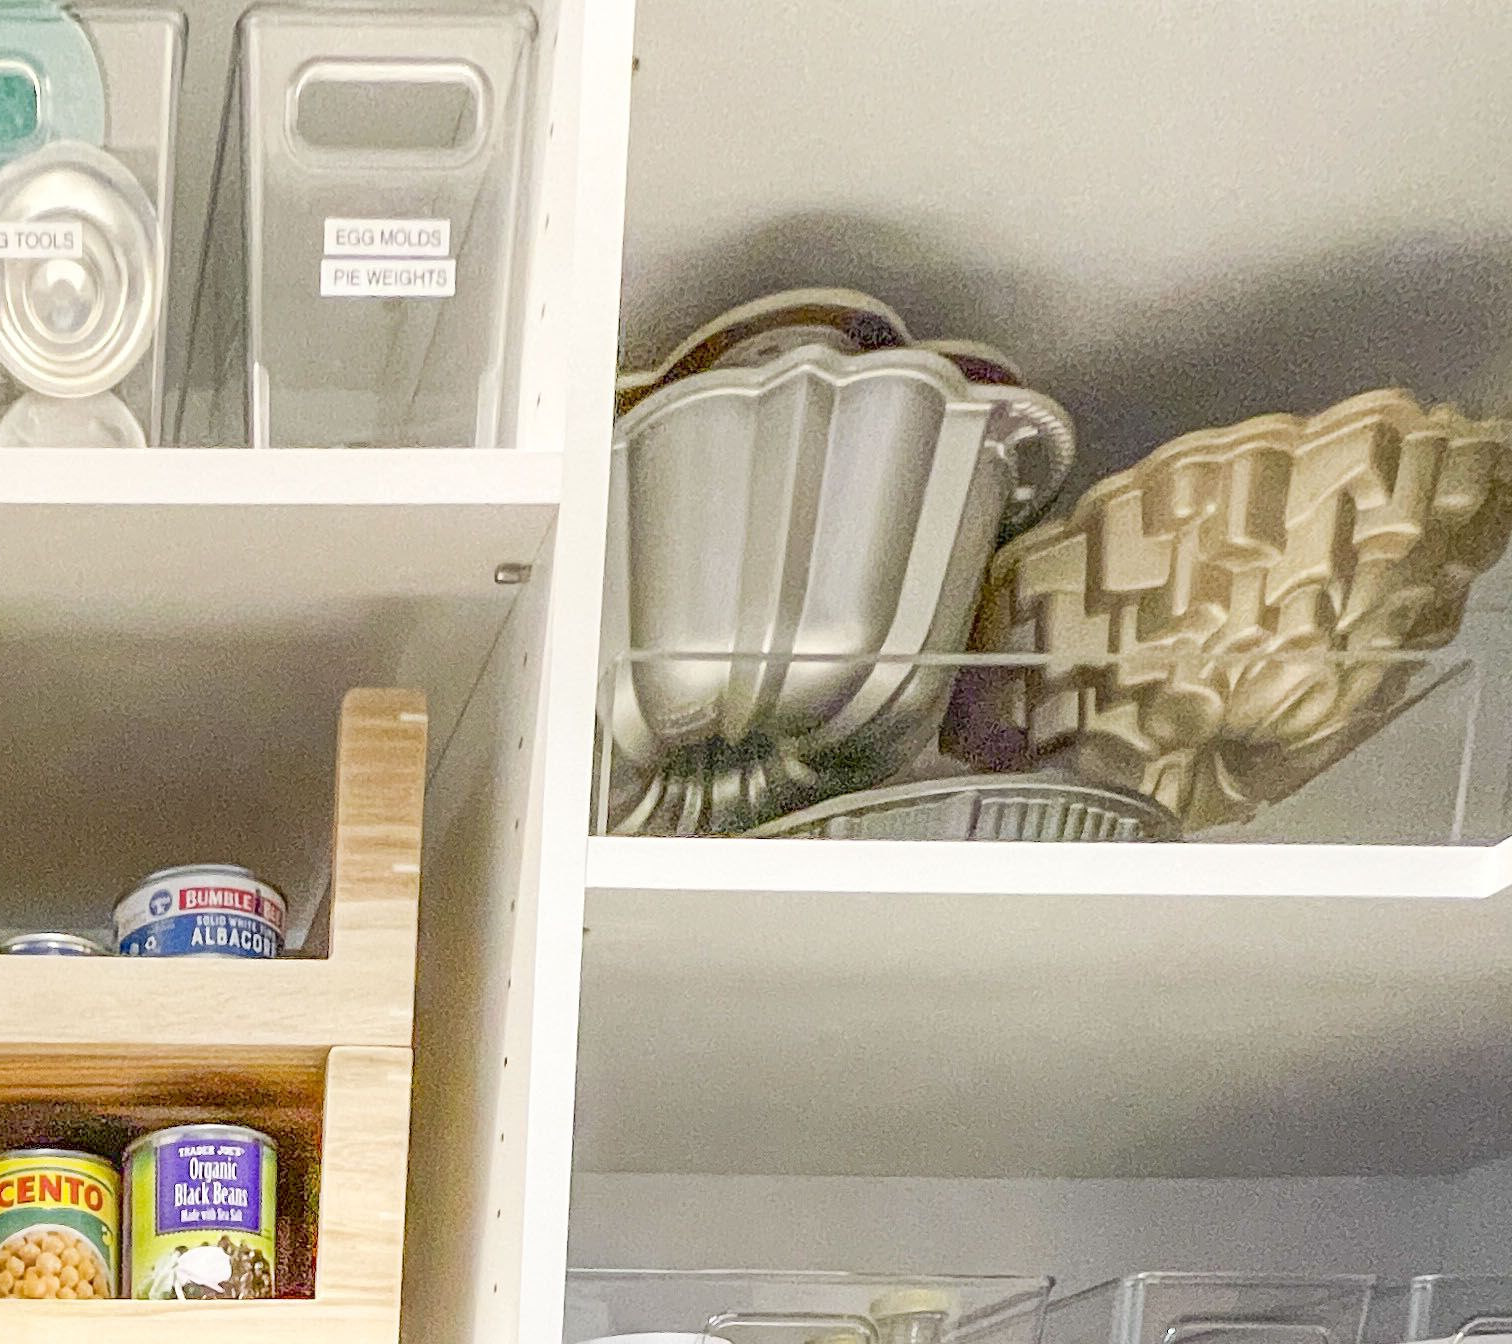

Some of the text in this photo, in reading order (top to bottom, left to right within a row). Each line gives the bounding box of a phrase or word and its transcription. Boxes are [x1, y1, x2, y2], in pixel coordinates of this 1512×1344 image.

[15, 231, 75, 251] TOOLS
[335, 228, 443, 249] EGG MOLDS
[333, 268, 447, 289] PIE WEIGHTS
[185, 888, 253, 913] BUMBLE
[189, 1156, 238, 1183] Organic
[174, 1181, 249, 1208] Black Beans
